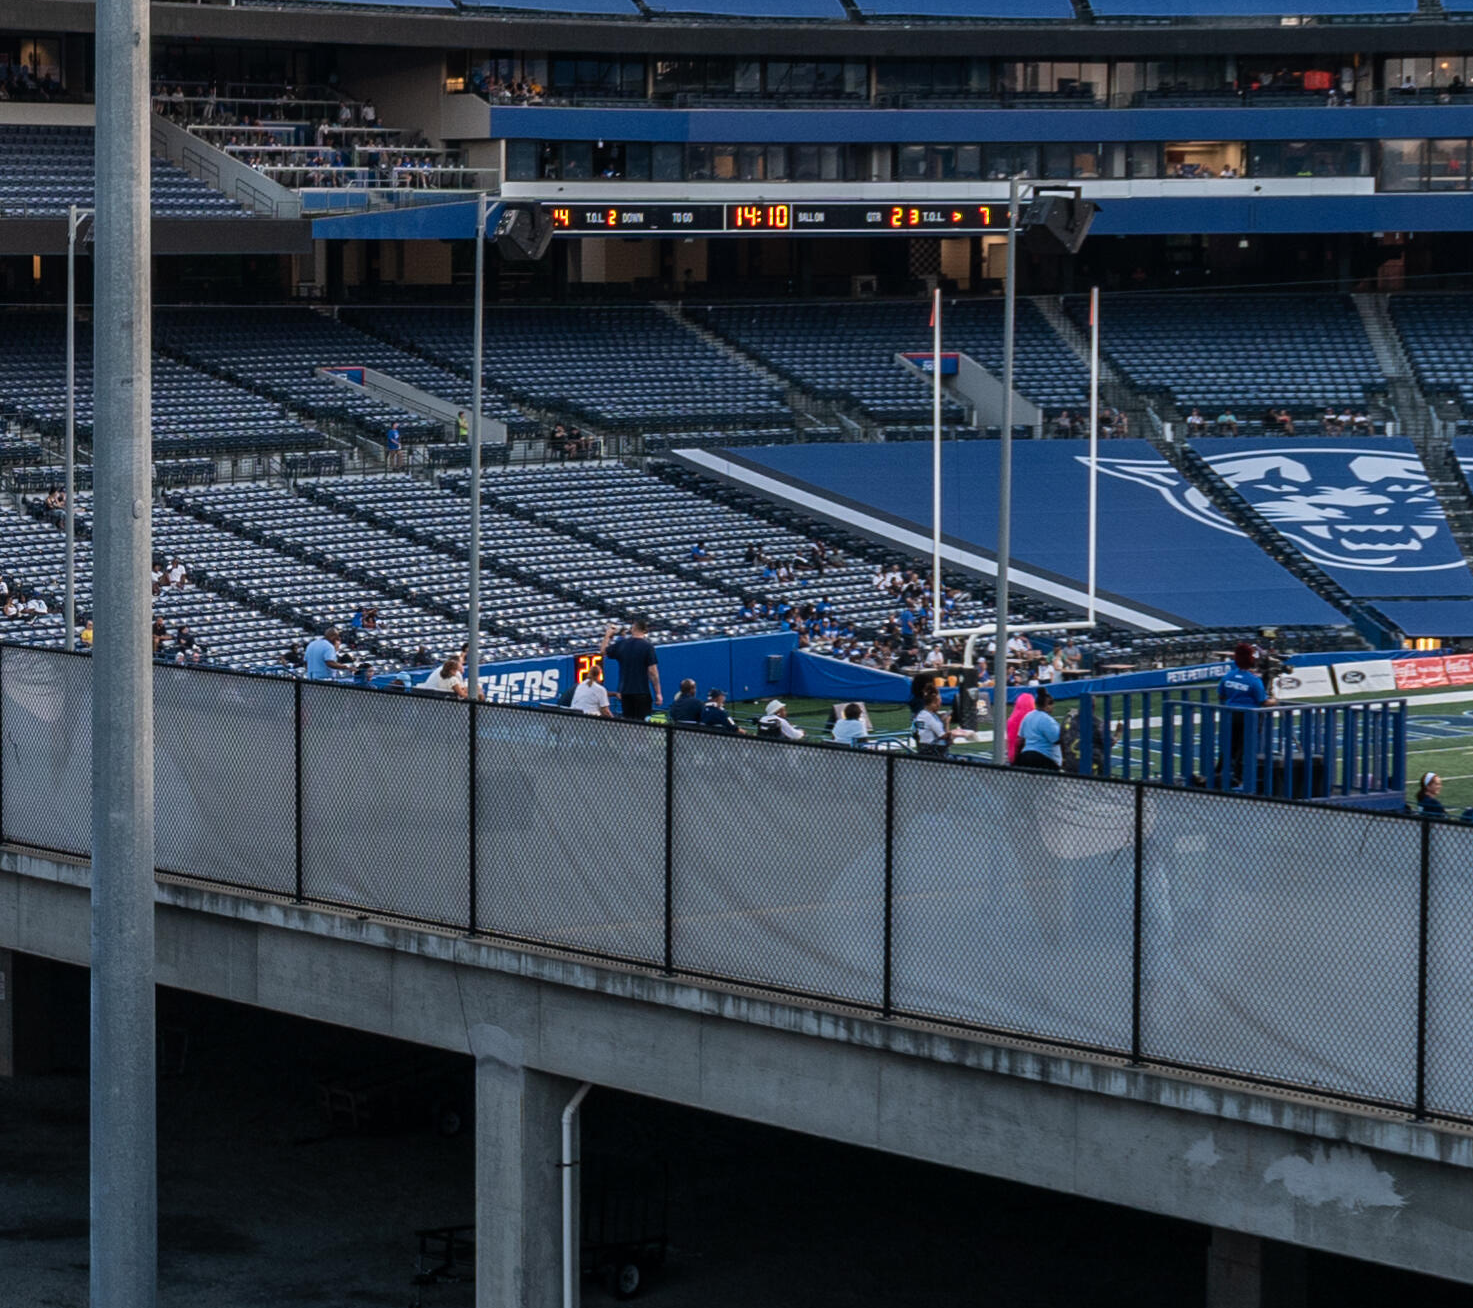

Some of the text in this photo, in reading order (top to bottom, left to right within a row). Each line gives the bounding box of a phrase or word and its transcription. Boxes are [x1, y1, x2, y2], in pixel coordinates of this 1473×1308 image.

[608, 209, 617, 227] 2
[622, 212, 644, 223] DOWN
[735, 204, 788, 229] 14:10
[1210, 665, 1231, 678] FIELD
